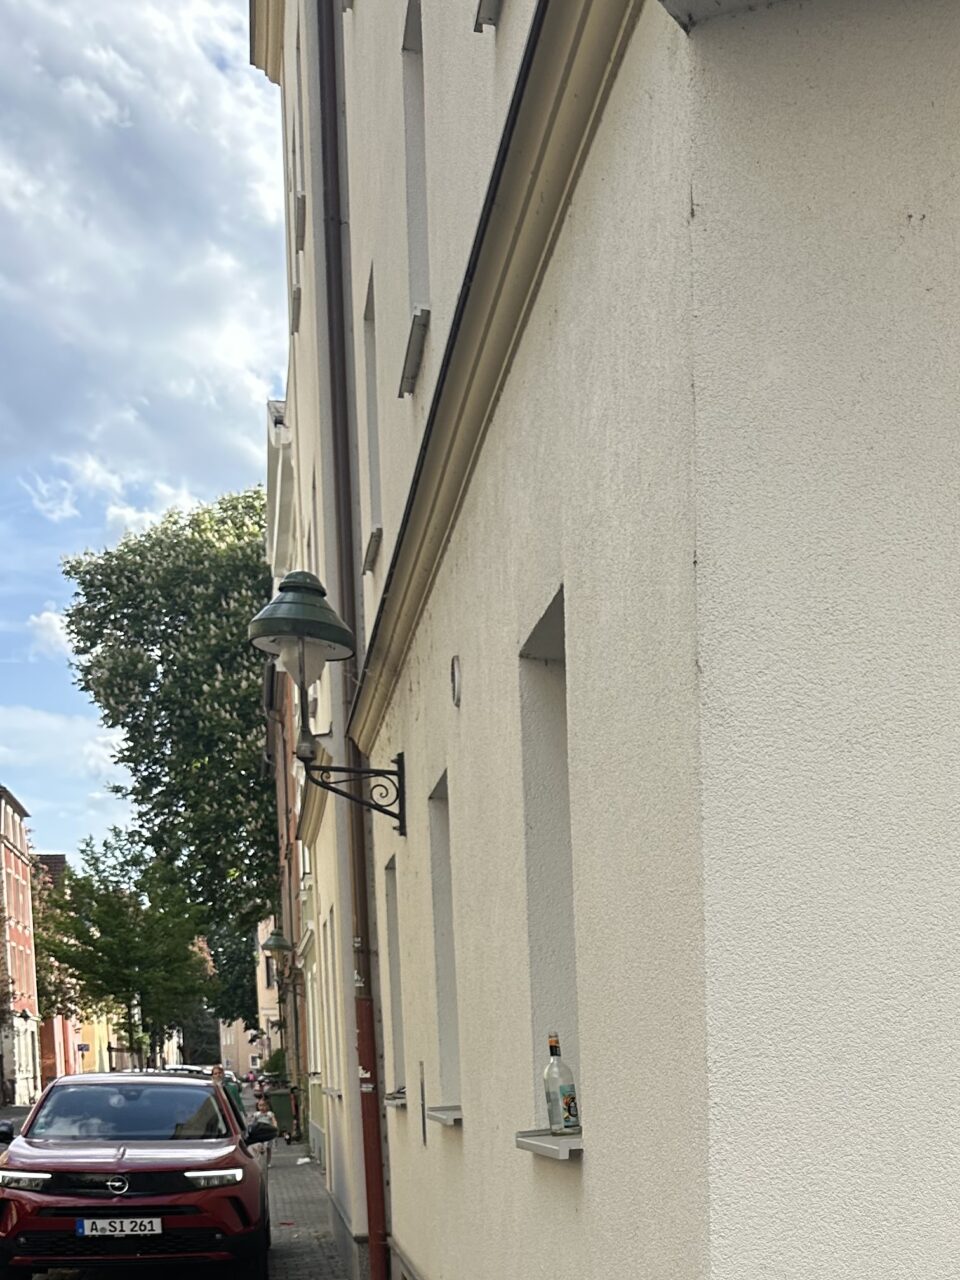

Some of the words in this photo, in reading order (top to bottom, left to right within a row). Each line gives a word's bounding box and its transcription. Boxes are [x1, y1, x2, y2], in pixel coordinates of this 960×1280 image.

[90, 1221, 98, 1232] A
[108, 1220, 126, 1233] SI
[130, 1220, 156, 1232] 261
